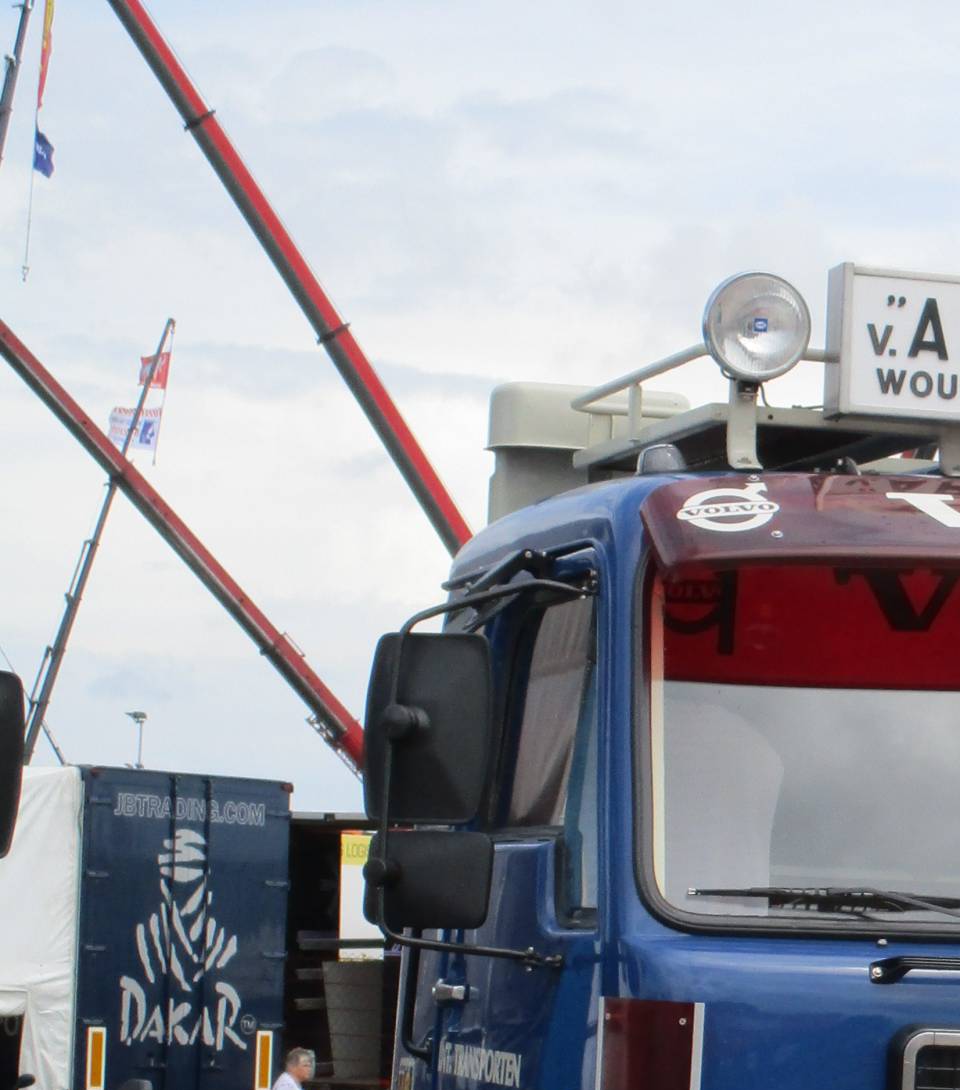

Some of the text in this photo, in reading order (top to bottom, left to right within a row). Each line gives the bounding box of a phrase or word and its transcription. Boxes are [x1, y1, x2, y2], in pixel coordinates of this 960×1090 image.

[684, 503, 774, 517] VOLVO
[120, 975, 247, 1051] DAKAR
[454, 1043, 522, 1088] TRANSPORTEN
